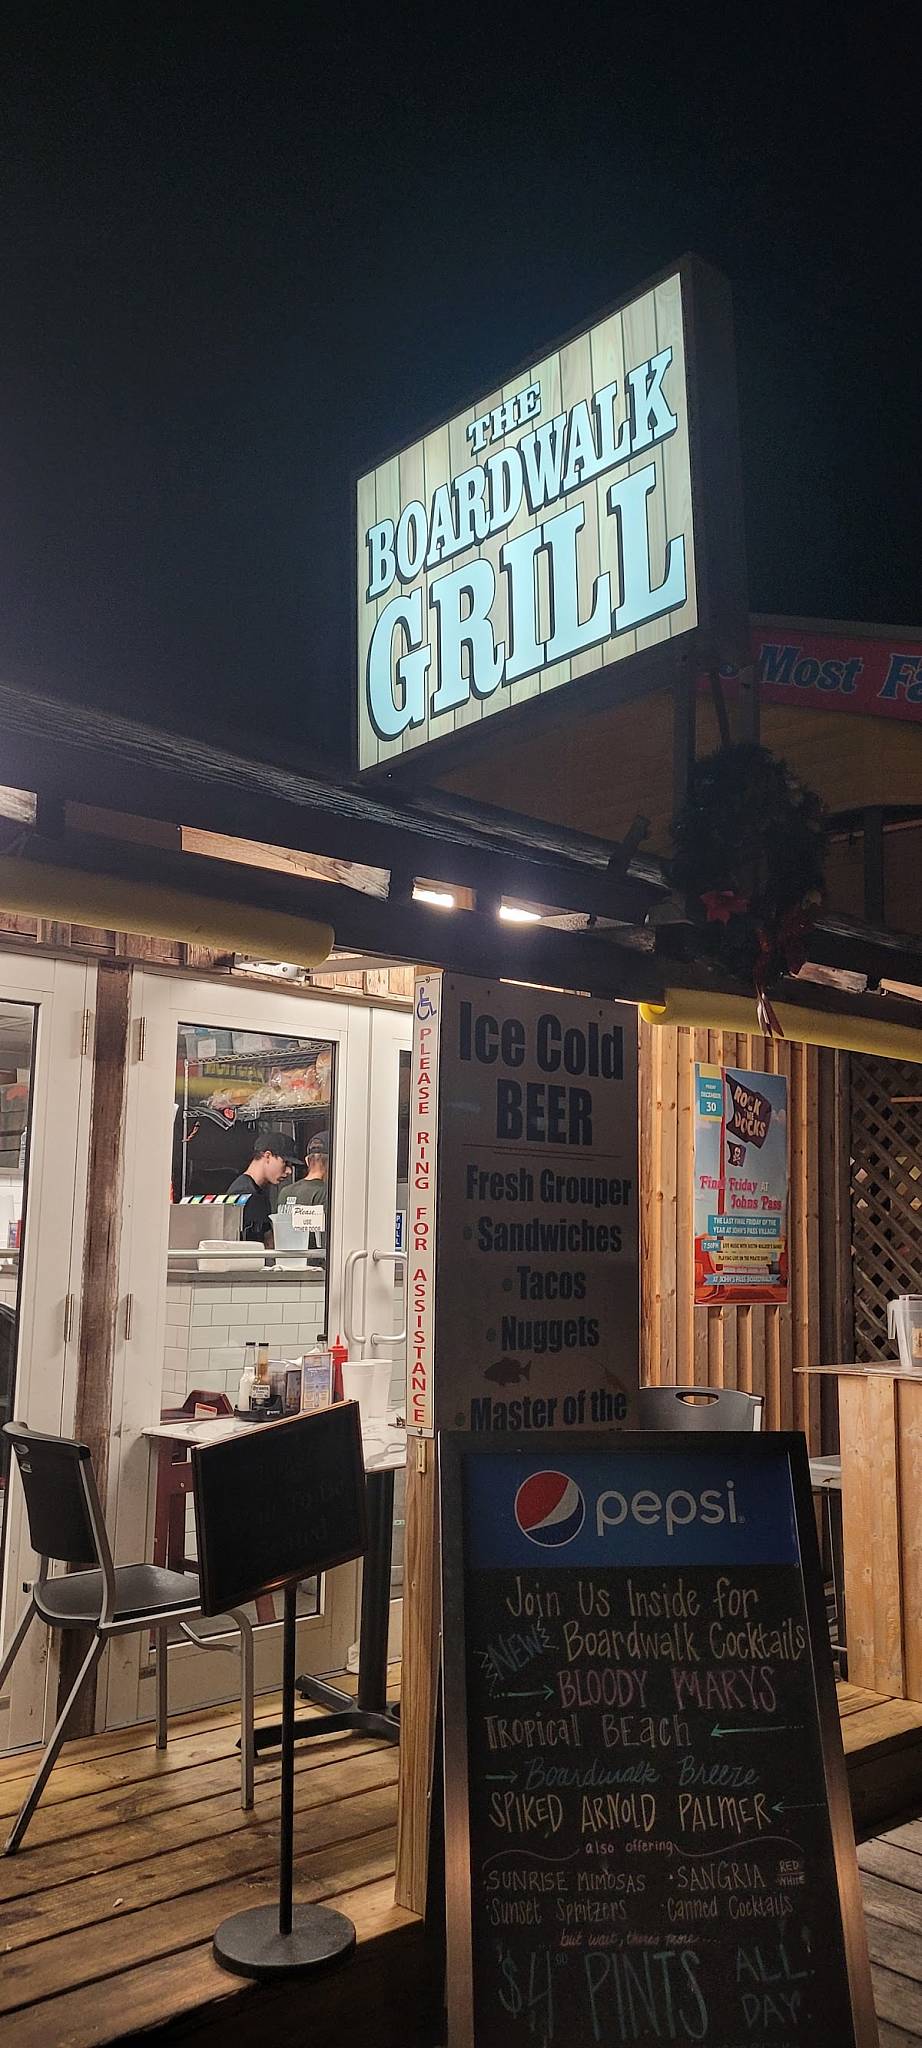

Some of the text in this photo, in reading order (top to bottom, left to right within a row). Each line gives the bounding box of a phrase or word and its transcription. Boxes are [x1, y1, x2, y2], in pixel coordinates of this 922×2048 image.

[467, 381, 541, 456] THE
[366, 346, 677, 602] BOARDWALK
[366, 463, 687, 742] GRILL
[759, 643, 863, 695] Most
[459, 1002, 624, 1082] Ice Cold
[417, 1027, 432, 1115] PLEASE
[496, 1078, 593, 1146] BEER
[706, 1101, 717, 1112] 30
[733, 1085, 762, 1116] ROCK
[734, 1112, 767, 1138] DOCKS
[415, 1131, 430, 1190] RING
[466, 1164, 632, 1207] Fresh Grouper
[728, 1177, 758, 1195] Friday
[730, 1194, 784, 1211] Johns Pass
[413, 1207, 429, 1251] FOR
[477, 1216, 622, 1253] Sandwiches
[516, 1265, 586, 1301] Tacos
[412, 1268, 428, 1424] ASSISTANCE
[501, 1316, 600, 1353] Nuggets
[470, 1388, 628, 1431] Master of the
[596, 1480, 738, 1537] pepsi
[506, 1576, 759, 1618] Join Us Inside for
[487, 1624, 545, 1680] NEW
[562, 1617, 806, 1662] Boardwalk Cocktails
[557, 1665, 777, 1713] BLOODY MARYS
[523, 1755, 760, 1790] Boardwalk Breeze
[488, 1791, 772, 1838] SPIKED ARNOLD PALMER
[585, 1839, 676, 1857] also offering
[488, 1860, 801, 1893] SUNRISE MIMOSAS SANGRIA RED
[490, 1891, 794, 1926] Sunset Spritzers Canned Cocktails
[583, 1949, 709, 2041] PINTS
